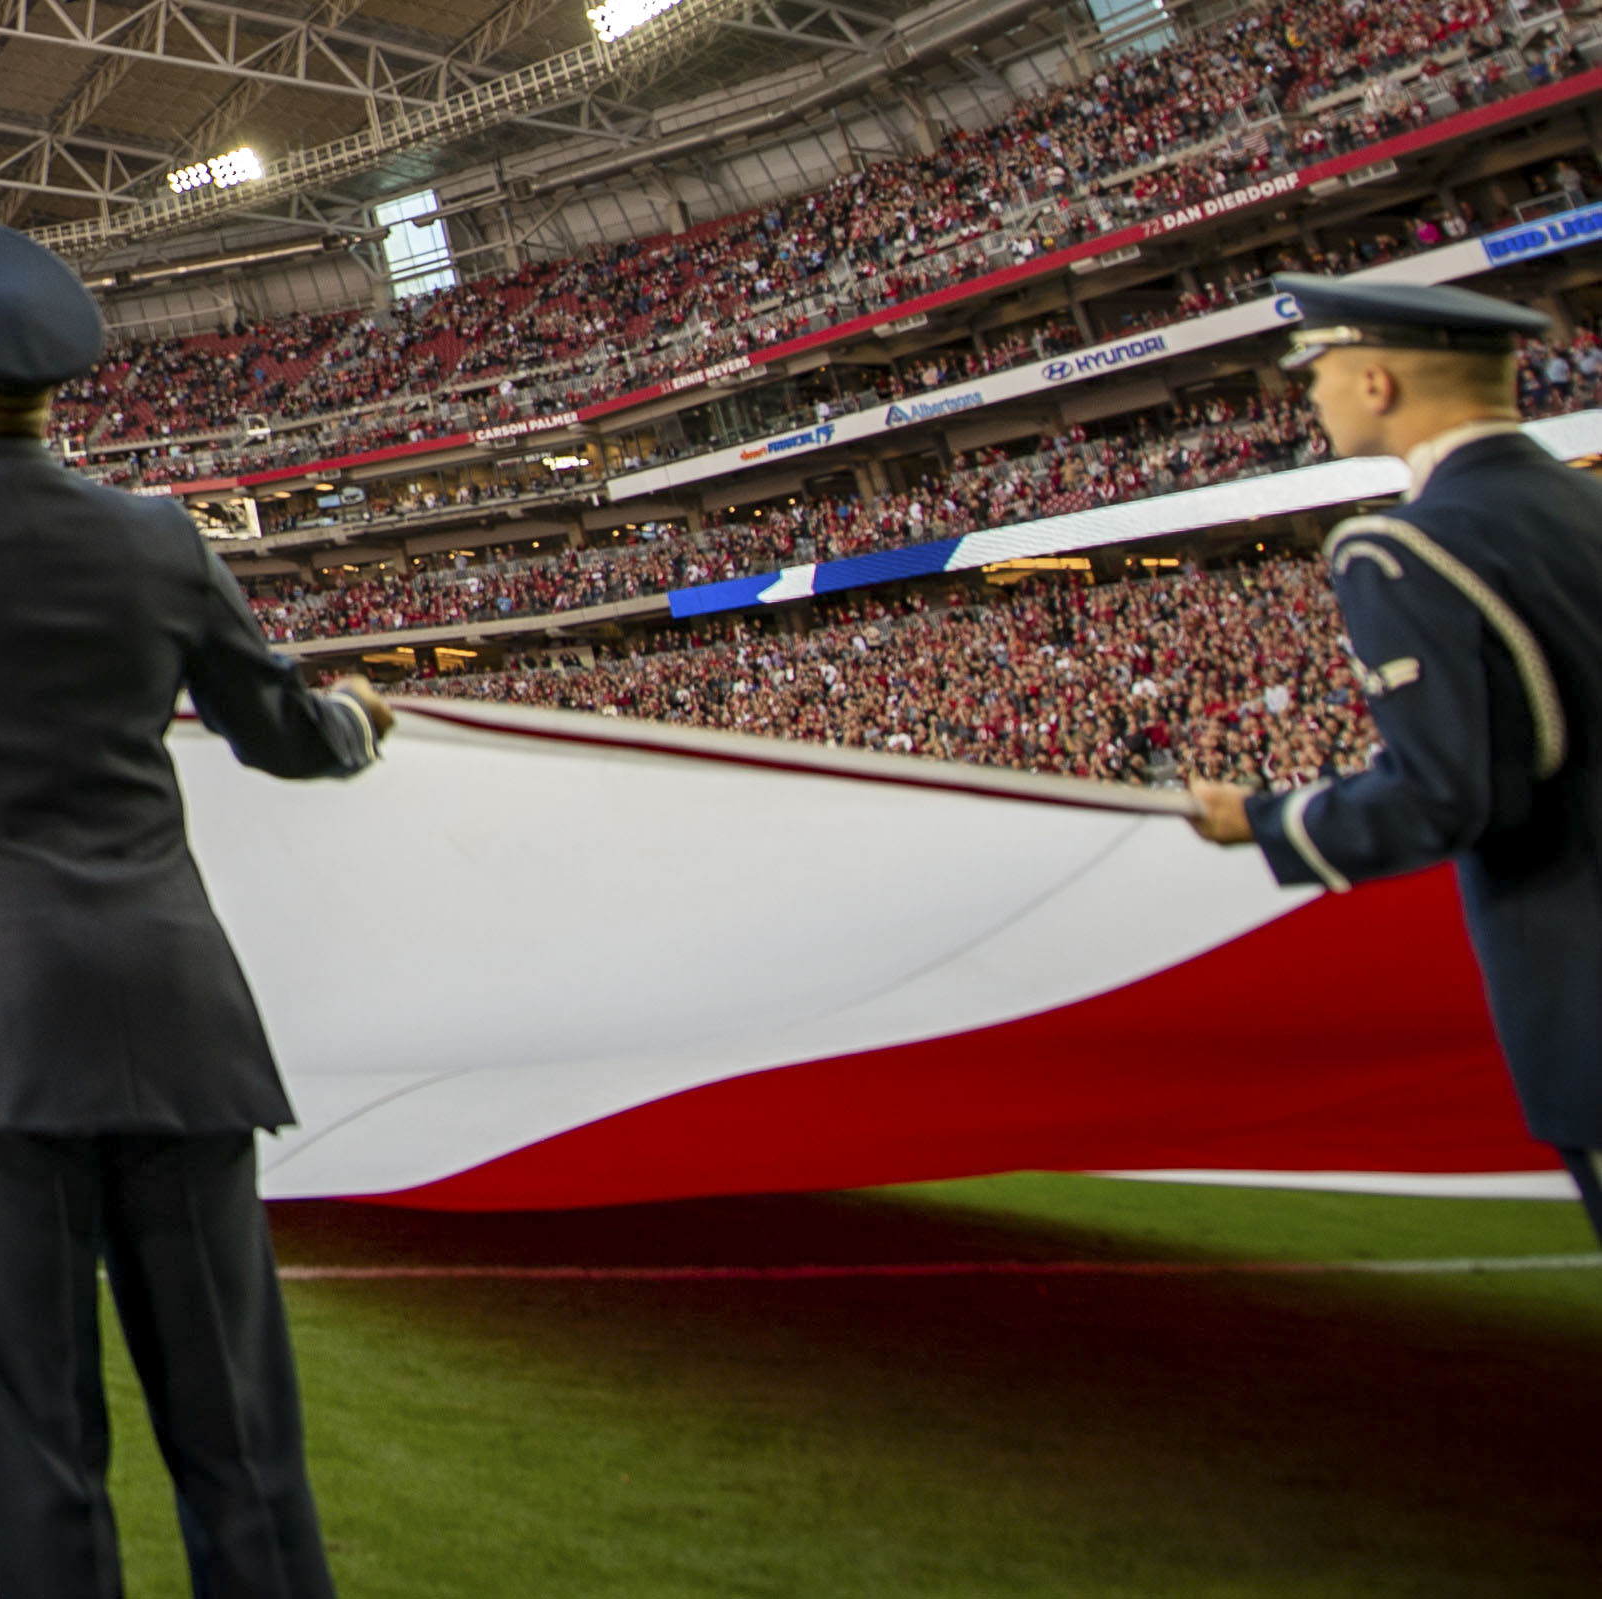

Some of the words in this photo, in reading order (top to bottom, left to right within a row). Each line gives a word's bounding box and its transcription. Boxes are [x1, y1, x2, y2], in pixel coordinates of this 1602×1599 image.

[1141, 218, 1162, 237] 72
[1162, 205, 1203, 231] DAN
[1203, 172, 1300, 216] DIERDORF
[1488, 230, 1548, 258] BUD
[1075, 335, 1166, 371] HYUNDAI
[672, 370, 705, 390] ERNIE
[705, 355, 751, 379] NEVERS
[476, 422, 528, 441] CARSON
[528, 411, 579, 431] PALMER
